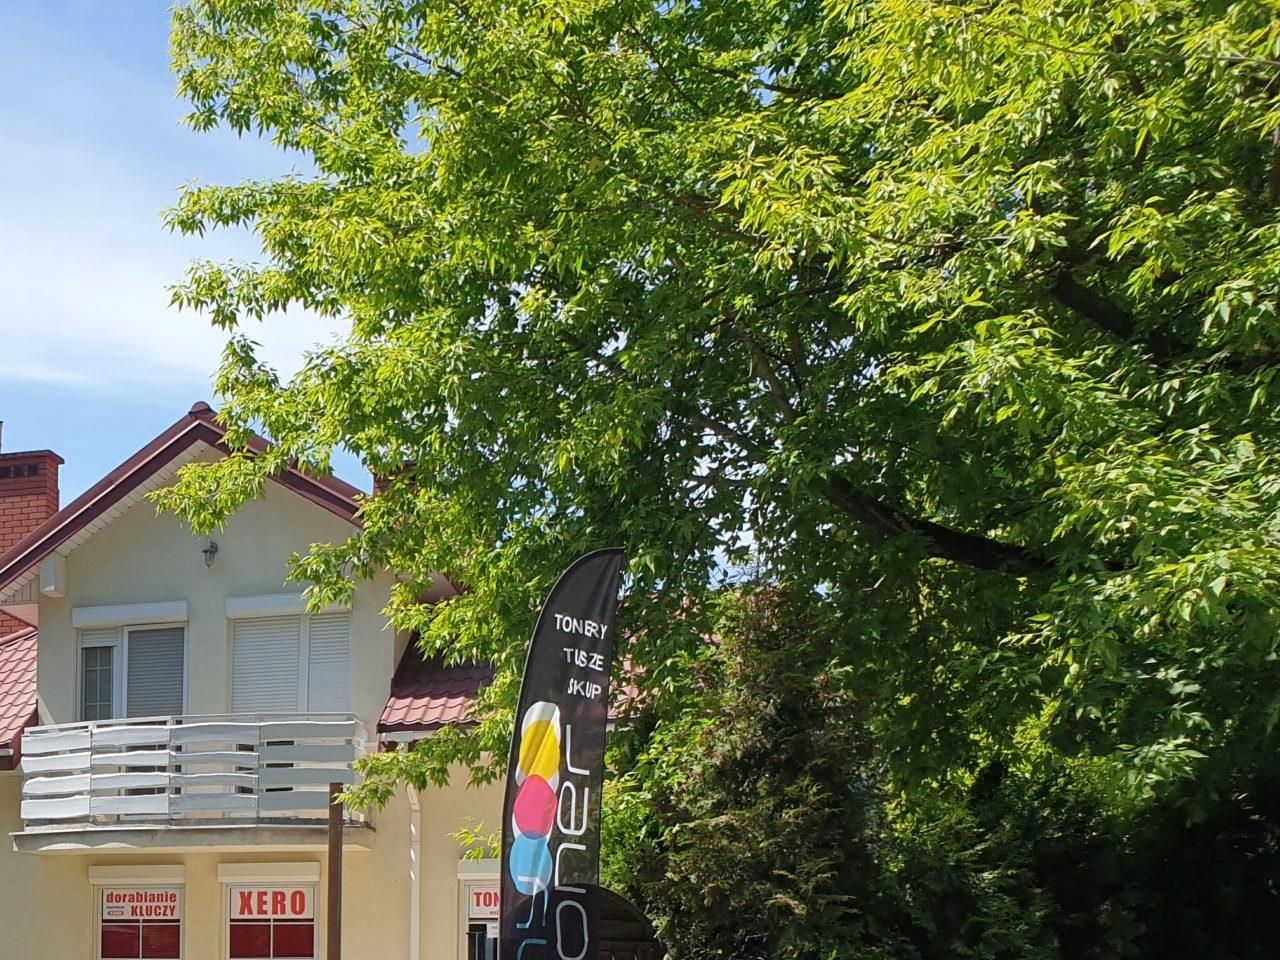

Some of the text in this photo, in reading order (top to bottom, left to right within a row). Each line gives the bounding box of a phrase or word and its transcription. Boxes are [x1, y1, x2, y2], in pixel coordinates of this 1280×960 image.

[554, 613, 608, 640] TONERY
[563, 647, 605, 671] TUSZE
[567, 677, 602, 699] SKUP
[106, 891, 177, 904] dorabianie
[238, 889, 306, 916] XERO
[473, 891, 501, 908] TON
[130, 905, 176, 917] KLUCZY
